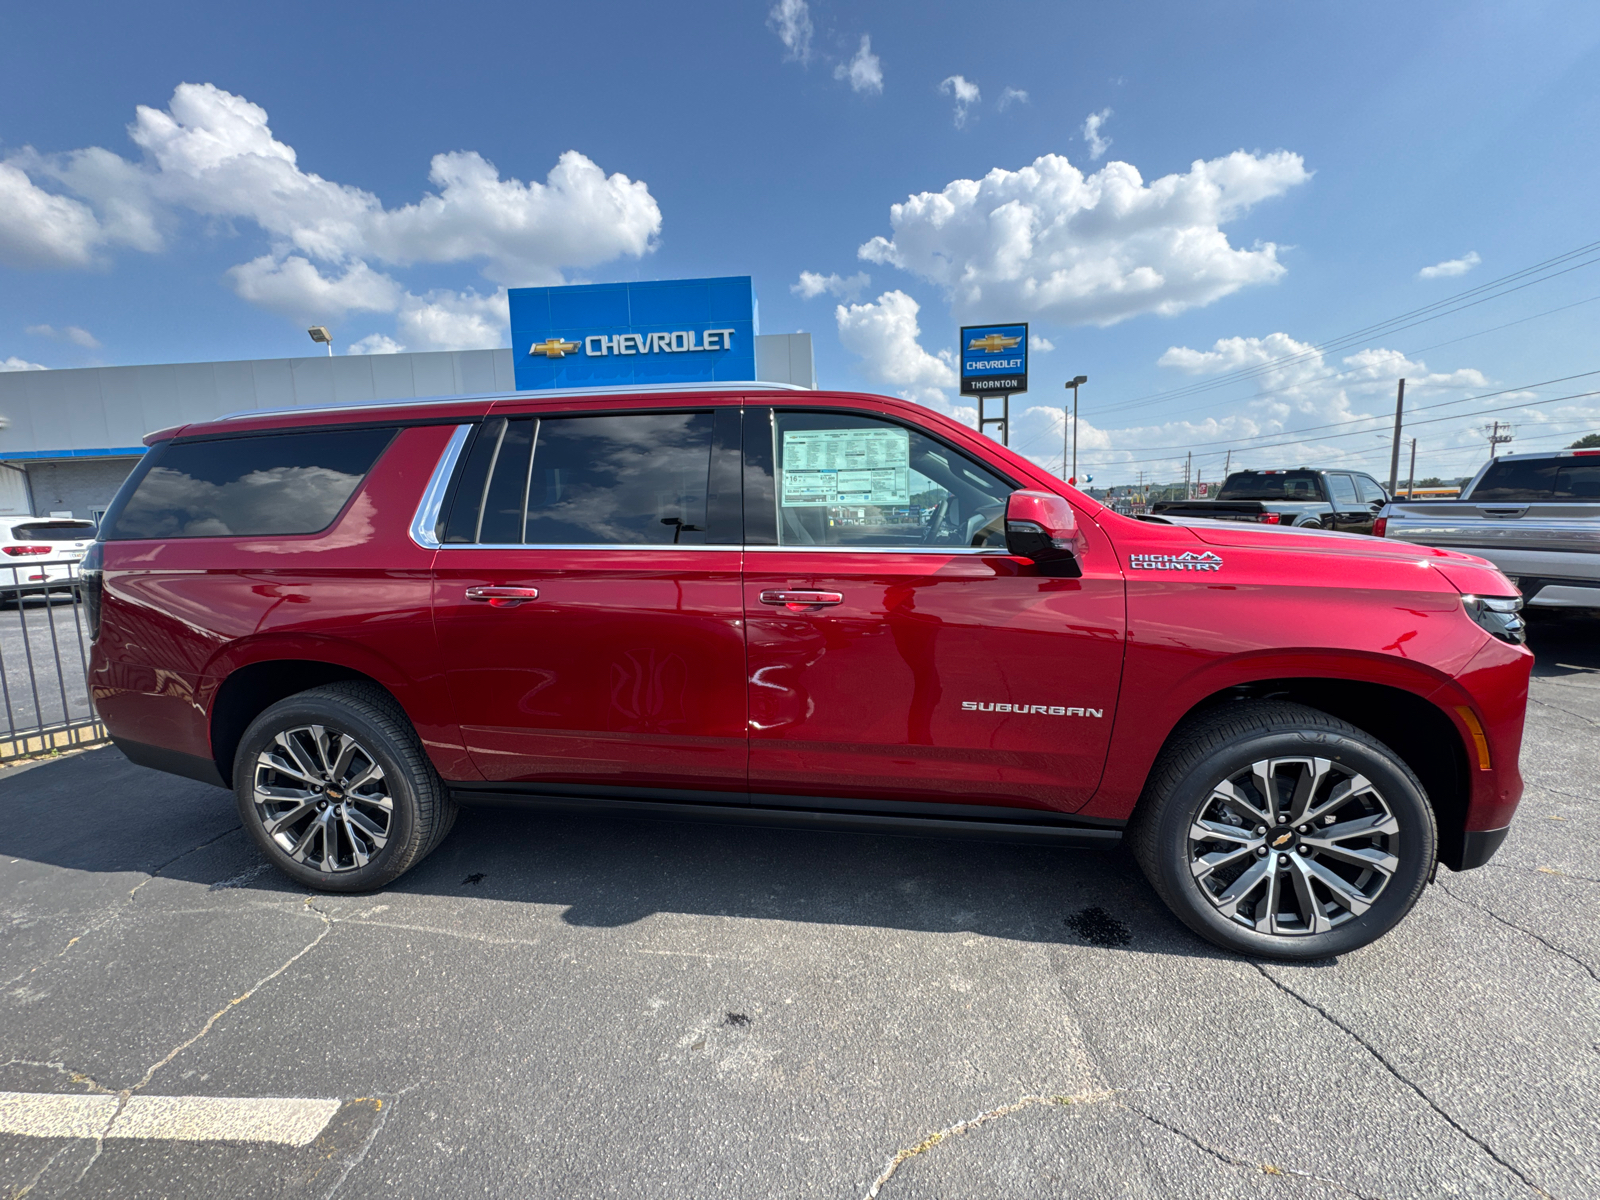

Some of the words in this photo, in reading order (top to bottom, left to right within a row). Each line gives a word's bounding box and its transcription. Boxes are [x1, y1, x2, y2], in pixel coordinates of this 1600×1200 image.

[585, 328, 735, 357] CHEVROLET
[966, 359, 1022, 370] CHEVROLET
[970, 379, 1018, 389] THORNTON
[1130, 553, 1176, 562] HIGH
[1130, 561, 1223, 571] COUNTRY
[961, 701, 1104, 718] SUBURBAN
